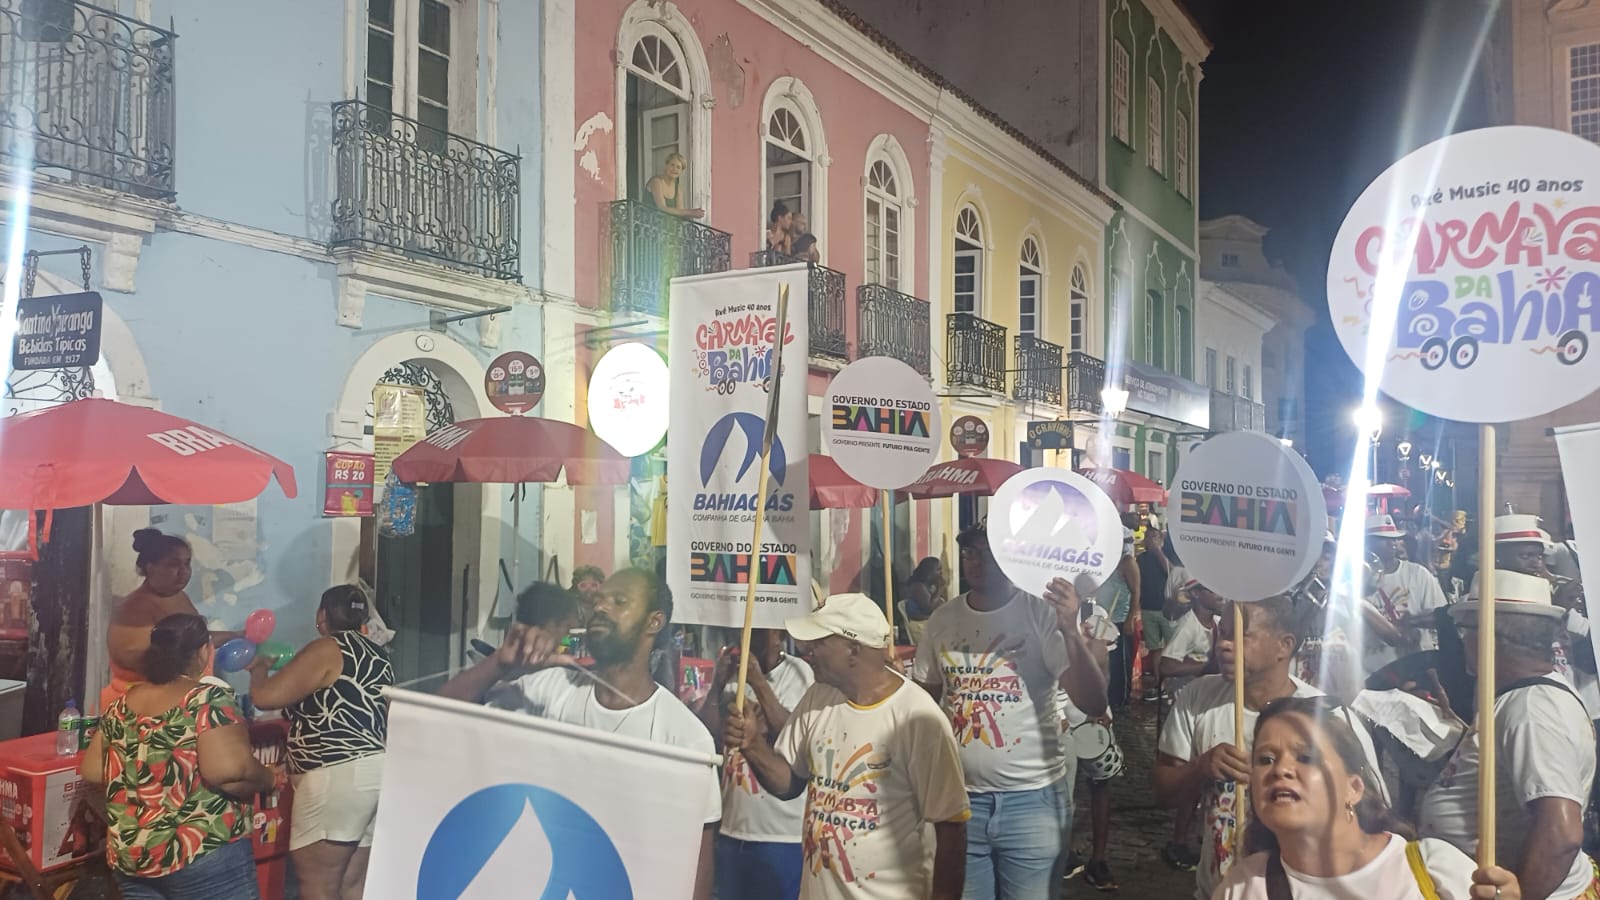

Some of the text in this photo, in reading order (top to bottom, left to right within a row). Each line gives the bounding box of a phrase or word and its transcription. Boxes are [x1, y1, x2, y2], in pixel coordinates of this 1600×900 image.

[1410, 178, 1584, 209] Aé Music 40 anos
[1454, 274, 1493, 299] DA
[728, 305, 746, 314] Music
[18, 337, 53, 354] Bebidas
[52, 356, 62, 364] EM
[729, 349, 741, 360] DA
[832, 395, 930, 411] GOVERNO DO ESTADO
[832, 404, 930, 438] BAHIA
[832, 438, 858, 446] GOVERNO
[914, 446, 930, 454] GENTE
[334, 469, 365, 481] R$ 20
[1181, 480, 1298, 501] GOVERNO DO ESTADO
[692, 514, 728, 523] COMPANHIA
[729, 515, 739, 523] DE
[1180, 491, 1297, 537] BAHIA
[691, 541, 734, 553] GOVERNO
[736, 543, 752, 553] DO
[1180, 534, 1296, 557] GOVERNO PRESENTE FUTURO PRA GENTE
[690, 552, 798, 586] BAHIA
[813, 809, 877, 832] TRADIÇÃO
